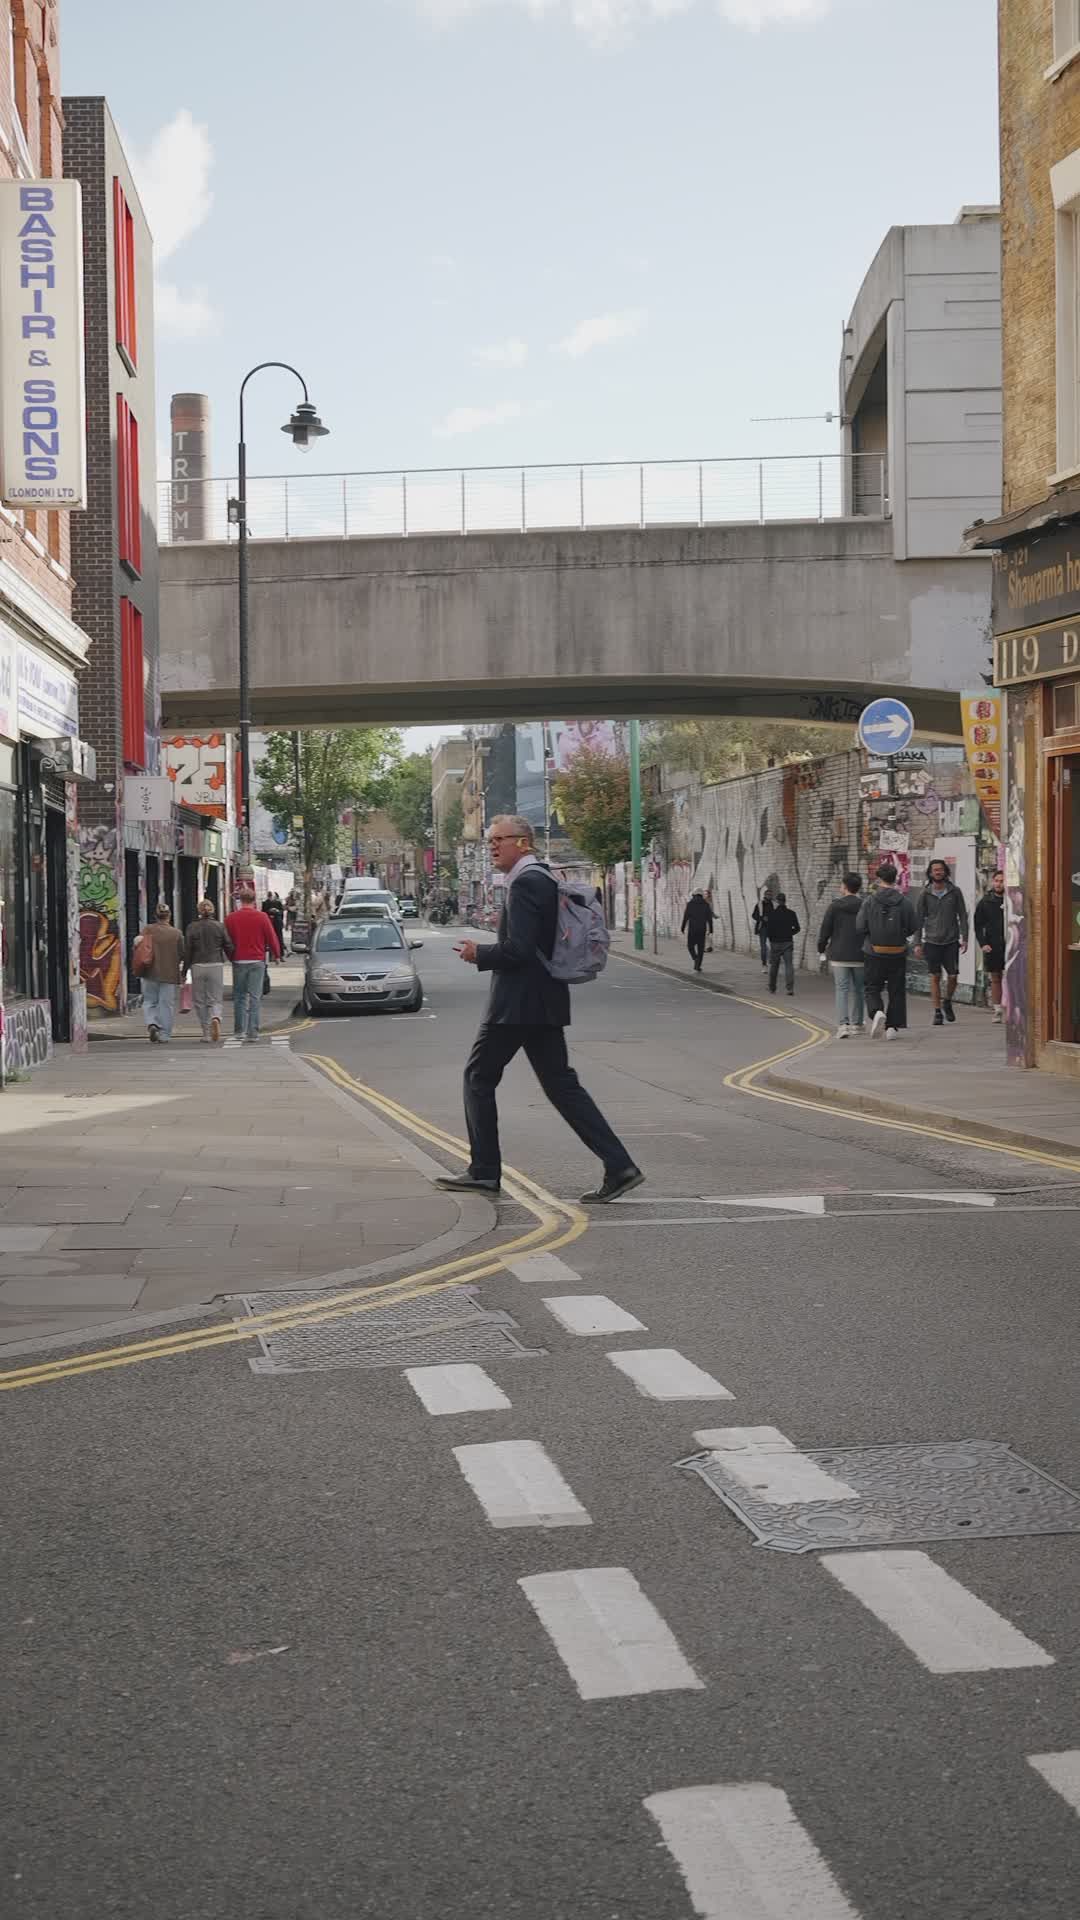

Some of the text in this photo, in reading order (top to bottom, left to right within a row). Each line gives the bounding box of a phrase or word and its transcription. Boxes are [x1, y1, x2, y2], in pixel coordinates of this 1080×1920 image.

[18, 187, 59, 480] BASHIR & SONS
[57, 488, 74, 497] LTD
[174, 432, 189, 541] TRUM
[1008, 564, 1064, 608] Shawarma
[1002, 635, 1040, 680] 119
